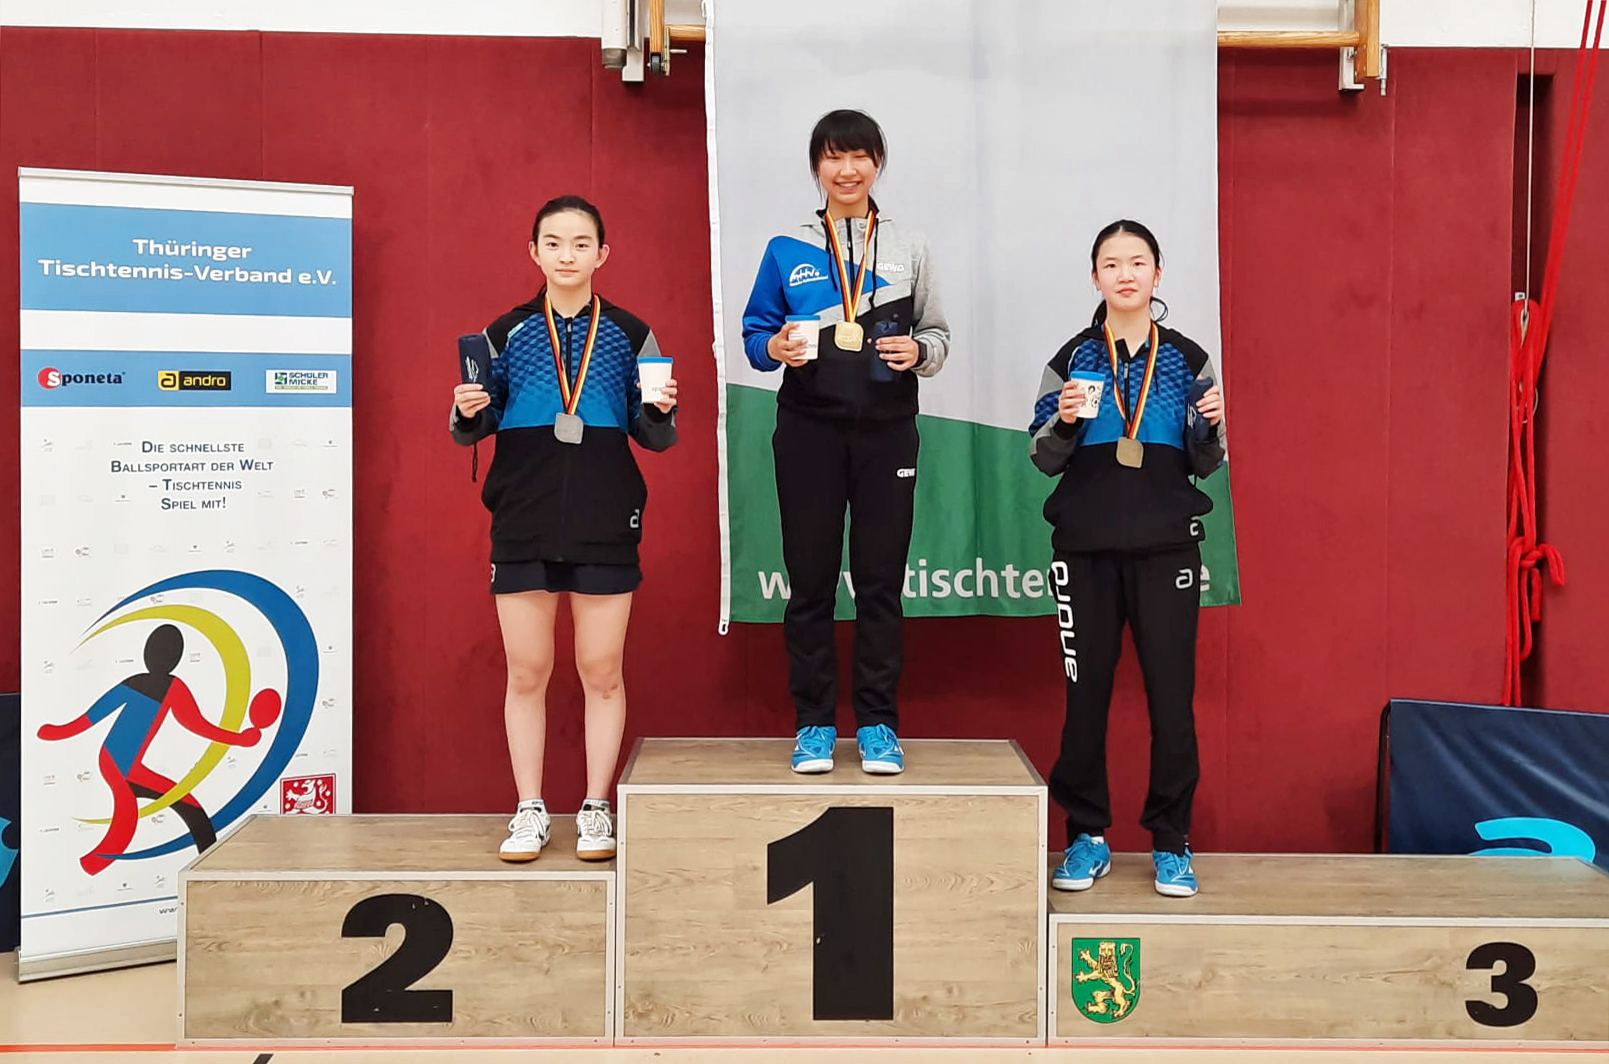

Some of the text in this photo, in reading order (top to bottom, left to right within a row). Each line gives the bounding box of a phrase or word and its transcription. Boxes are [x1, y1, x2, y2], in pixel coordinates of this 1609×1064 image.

[37, 258, 337, 285] Tischtennis-Verband e.V.
[132, 238, 253, 262] Thüringer
[183, 374, 226, 387] andro
[767, 806, 894, 1021] 1
[341, 893, 454, 1024] 2
[1465, 942, 1538, 1027] 3
